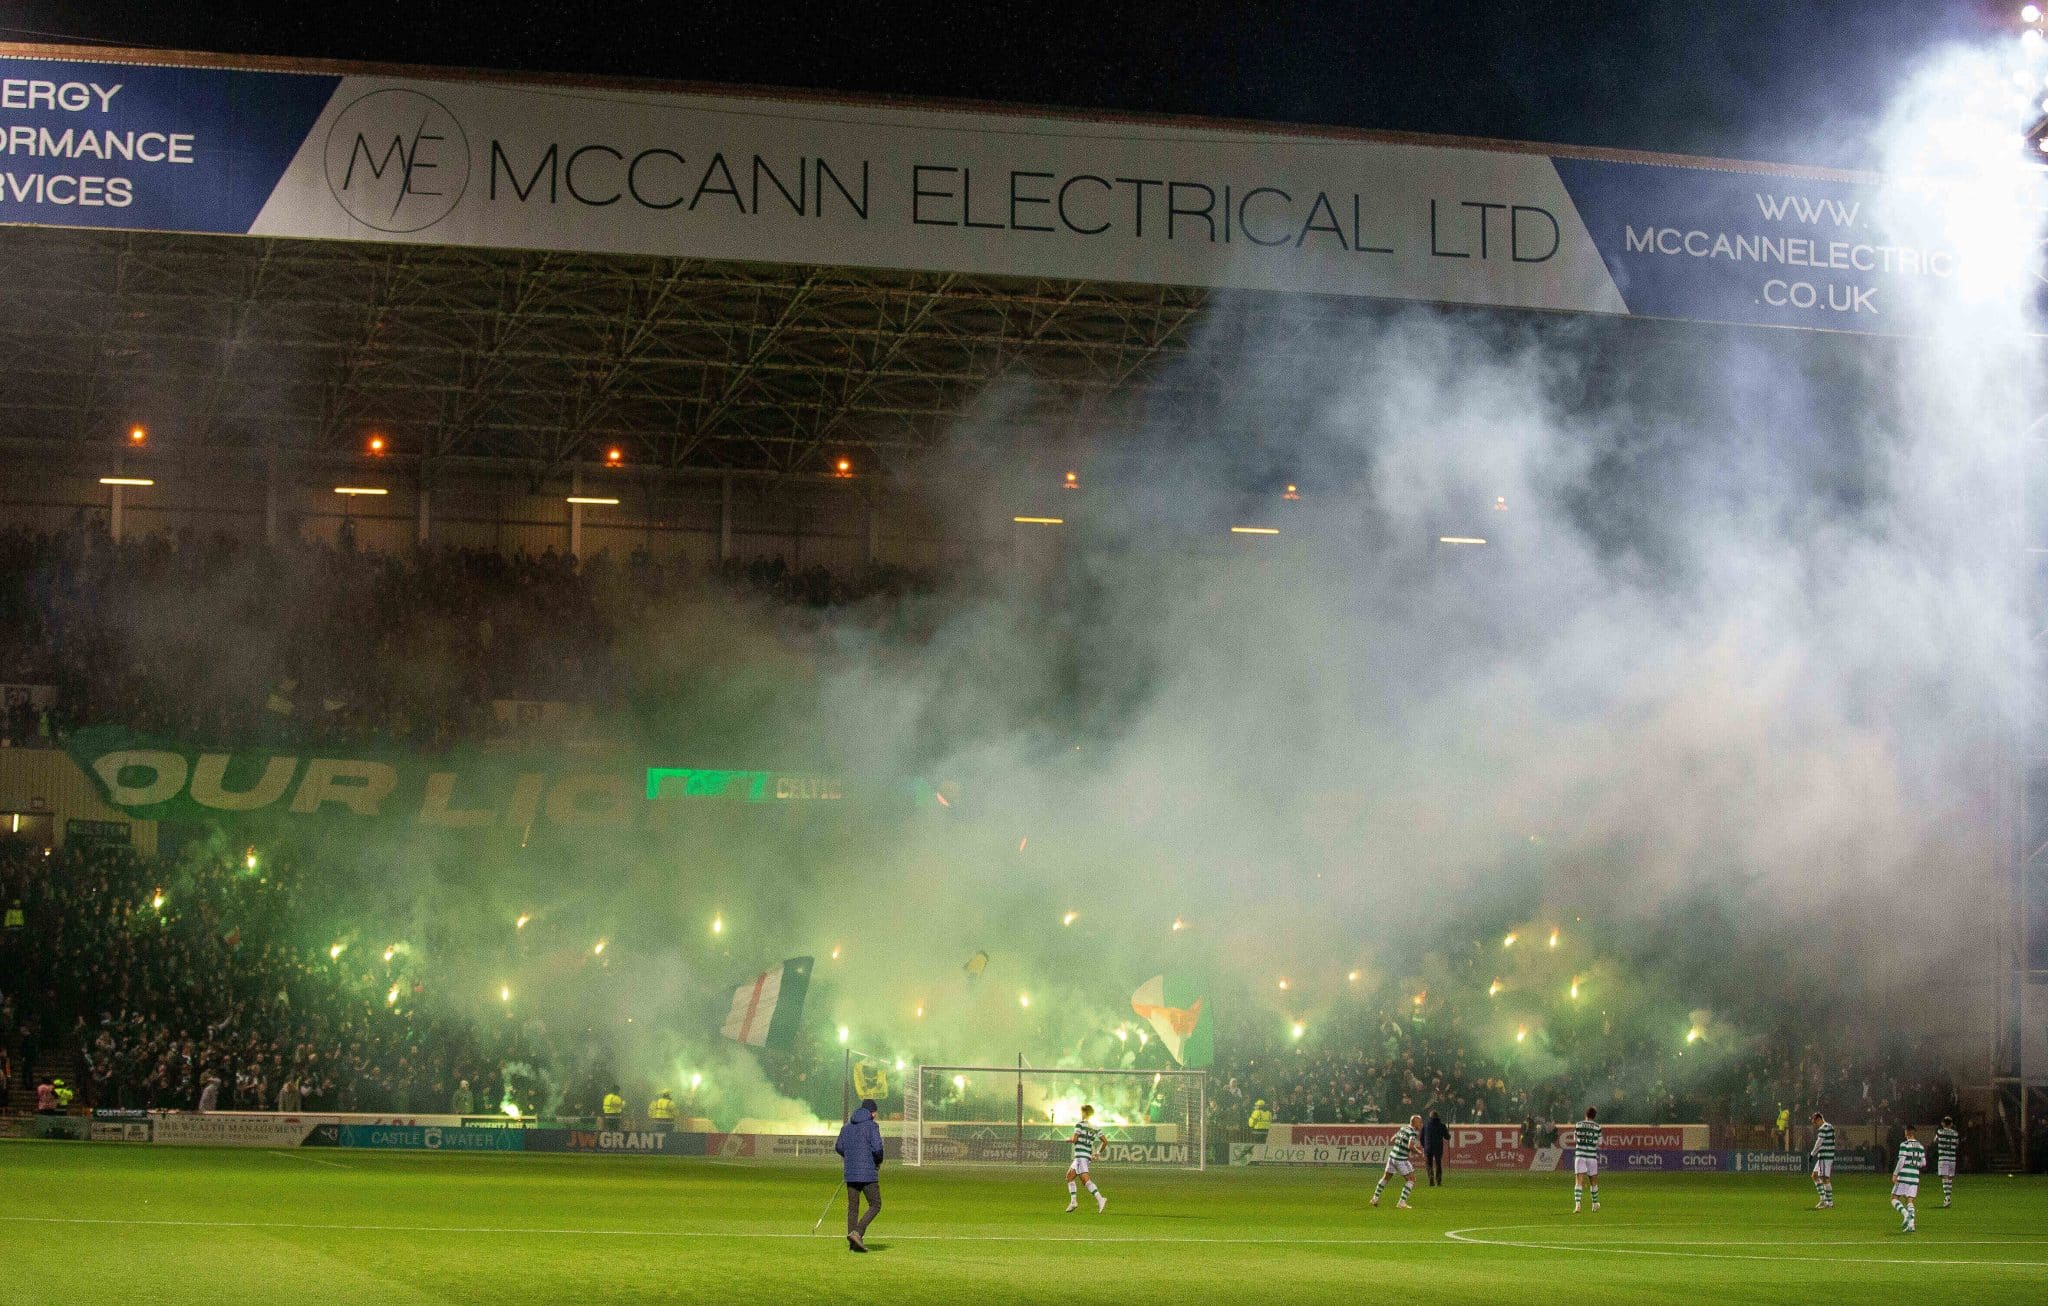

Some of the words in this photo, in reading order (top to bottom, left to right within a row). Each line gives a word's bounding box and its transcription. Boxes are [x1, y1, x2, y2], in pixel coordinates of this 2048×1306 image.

[0, 126, 195, 164] RMANCE
[490, 139, 869, 220] MCCANN
[912, 164, 1394, 254] ELECTRICAL
[1430, 199, 1561, 263] LTD
[92, 750, 399, 816] OUR
[228, 1123, 304, 1134] MANAGEMENT
[371, 1131, 420, 1145] CASTLE
[444, 1133, 494, 1147] WATER
[1304, 1134, 1390, 1146] NEWTOWN
[1600, 1135, 1680, 1146] NEWTOWN
[1264, 1145, 1306, 1161] Love
[1313, 1147, 1329, 1161] to
[1337, 1146, 1387, 1162] Travel
[1628, 1152, 1663, 1166] cinch
[1682, 1153, 1717, 1167] cinch
[1747, 1152, 1802, 1164] Caledonian
